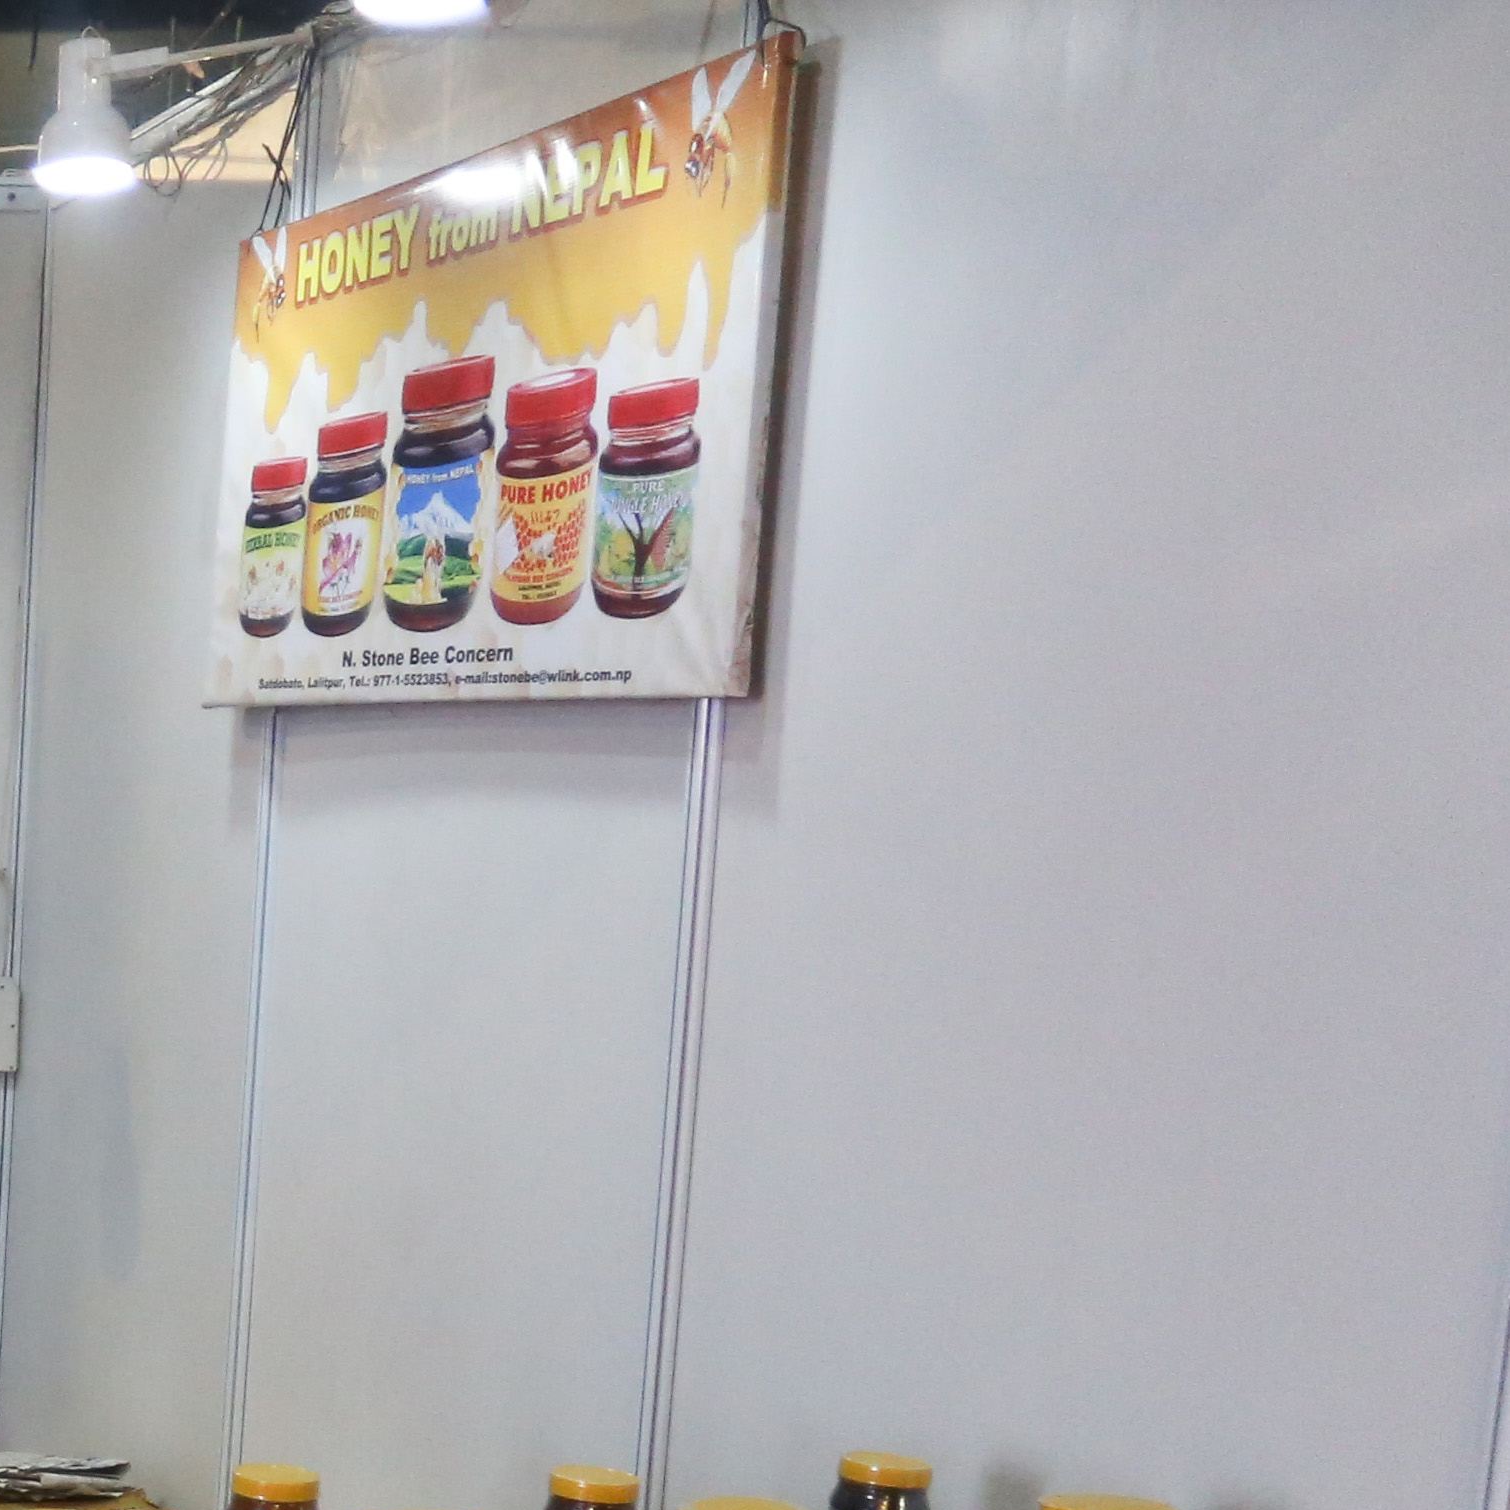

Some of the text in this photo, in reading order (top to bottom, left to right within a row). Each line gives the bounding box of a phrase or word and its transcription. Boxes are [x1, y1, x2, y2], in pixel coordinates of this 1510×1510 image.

[296, 123, 670, 307] HONEY from NEPAL
[501, 471, 591, 505] PURE HONEY
[632, 480, 664, 493] PURE
[342, 646, 513, 667] N. Stone Bee Concern
